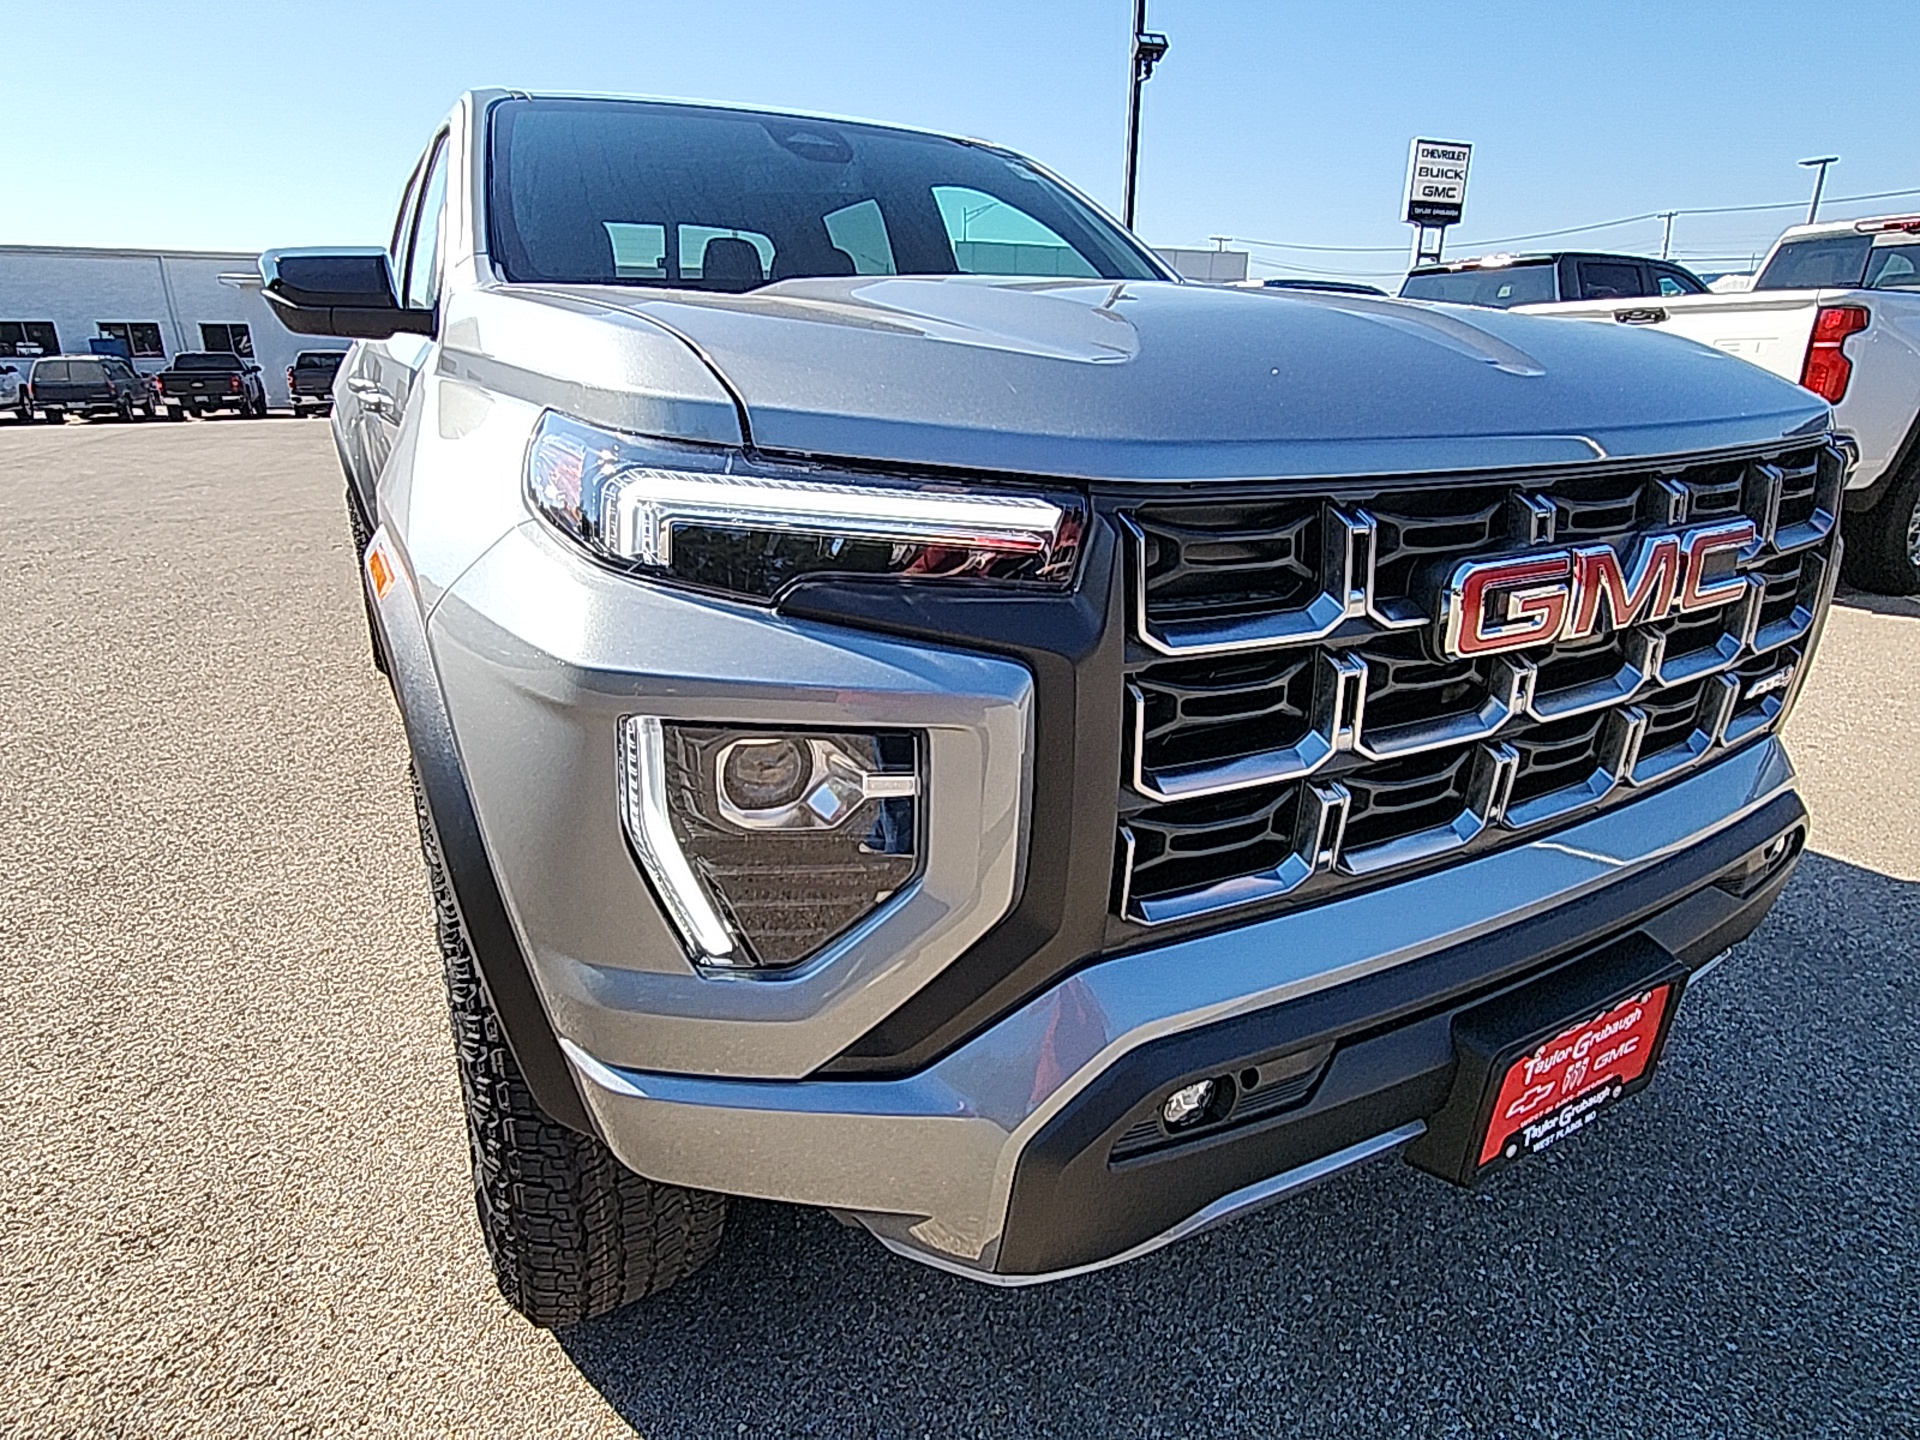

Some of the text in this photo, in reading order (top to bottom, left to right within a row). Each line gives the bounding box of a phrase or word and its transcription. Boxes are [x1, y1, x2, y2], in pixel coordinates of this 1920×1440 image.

[1421, 148, 1467, 161] CHEVROLET
[1418, 166, 1464, 180] BUICK
[1422, 185, 1457, 198] GMC
[1444, 520, 1756, 658] GMC
[1524, 1046, 1573, 1086] Taylor
[1572, 1007, 1643, 1060] Grubaugh
[1593, 1036, 1640, 1071] GMC
[1523, 1116, 1559, 1147] Taylor
[1559, 1086, 1612, 1127] Grubaugh
